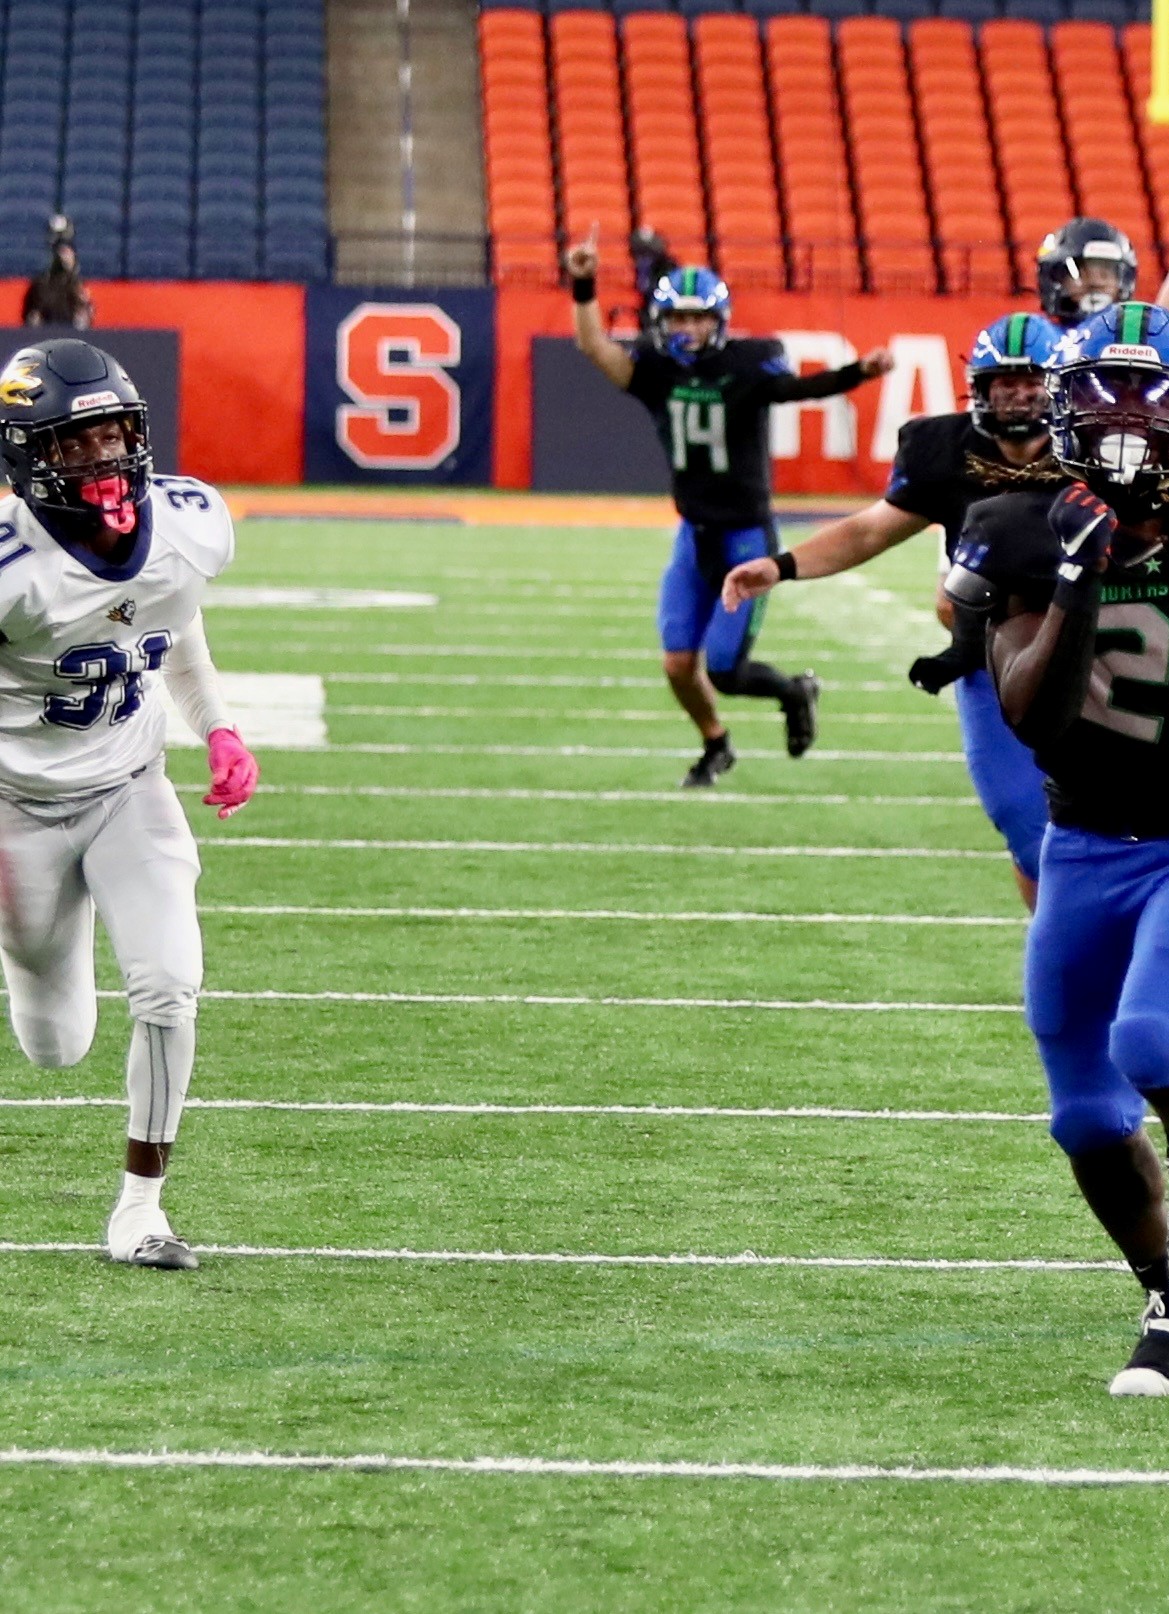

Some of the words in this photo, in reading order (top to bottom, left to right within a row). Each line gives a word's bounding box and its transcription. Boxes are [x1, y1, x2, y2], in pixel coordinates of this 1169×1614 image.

[334, 301, 461, 471] S
[1109, 346, 1152, 356] Riddell
[666, 399, 730, 472] 14
[39, 629, 173, 732] 31
